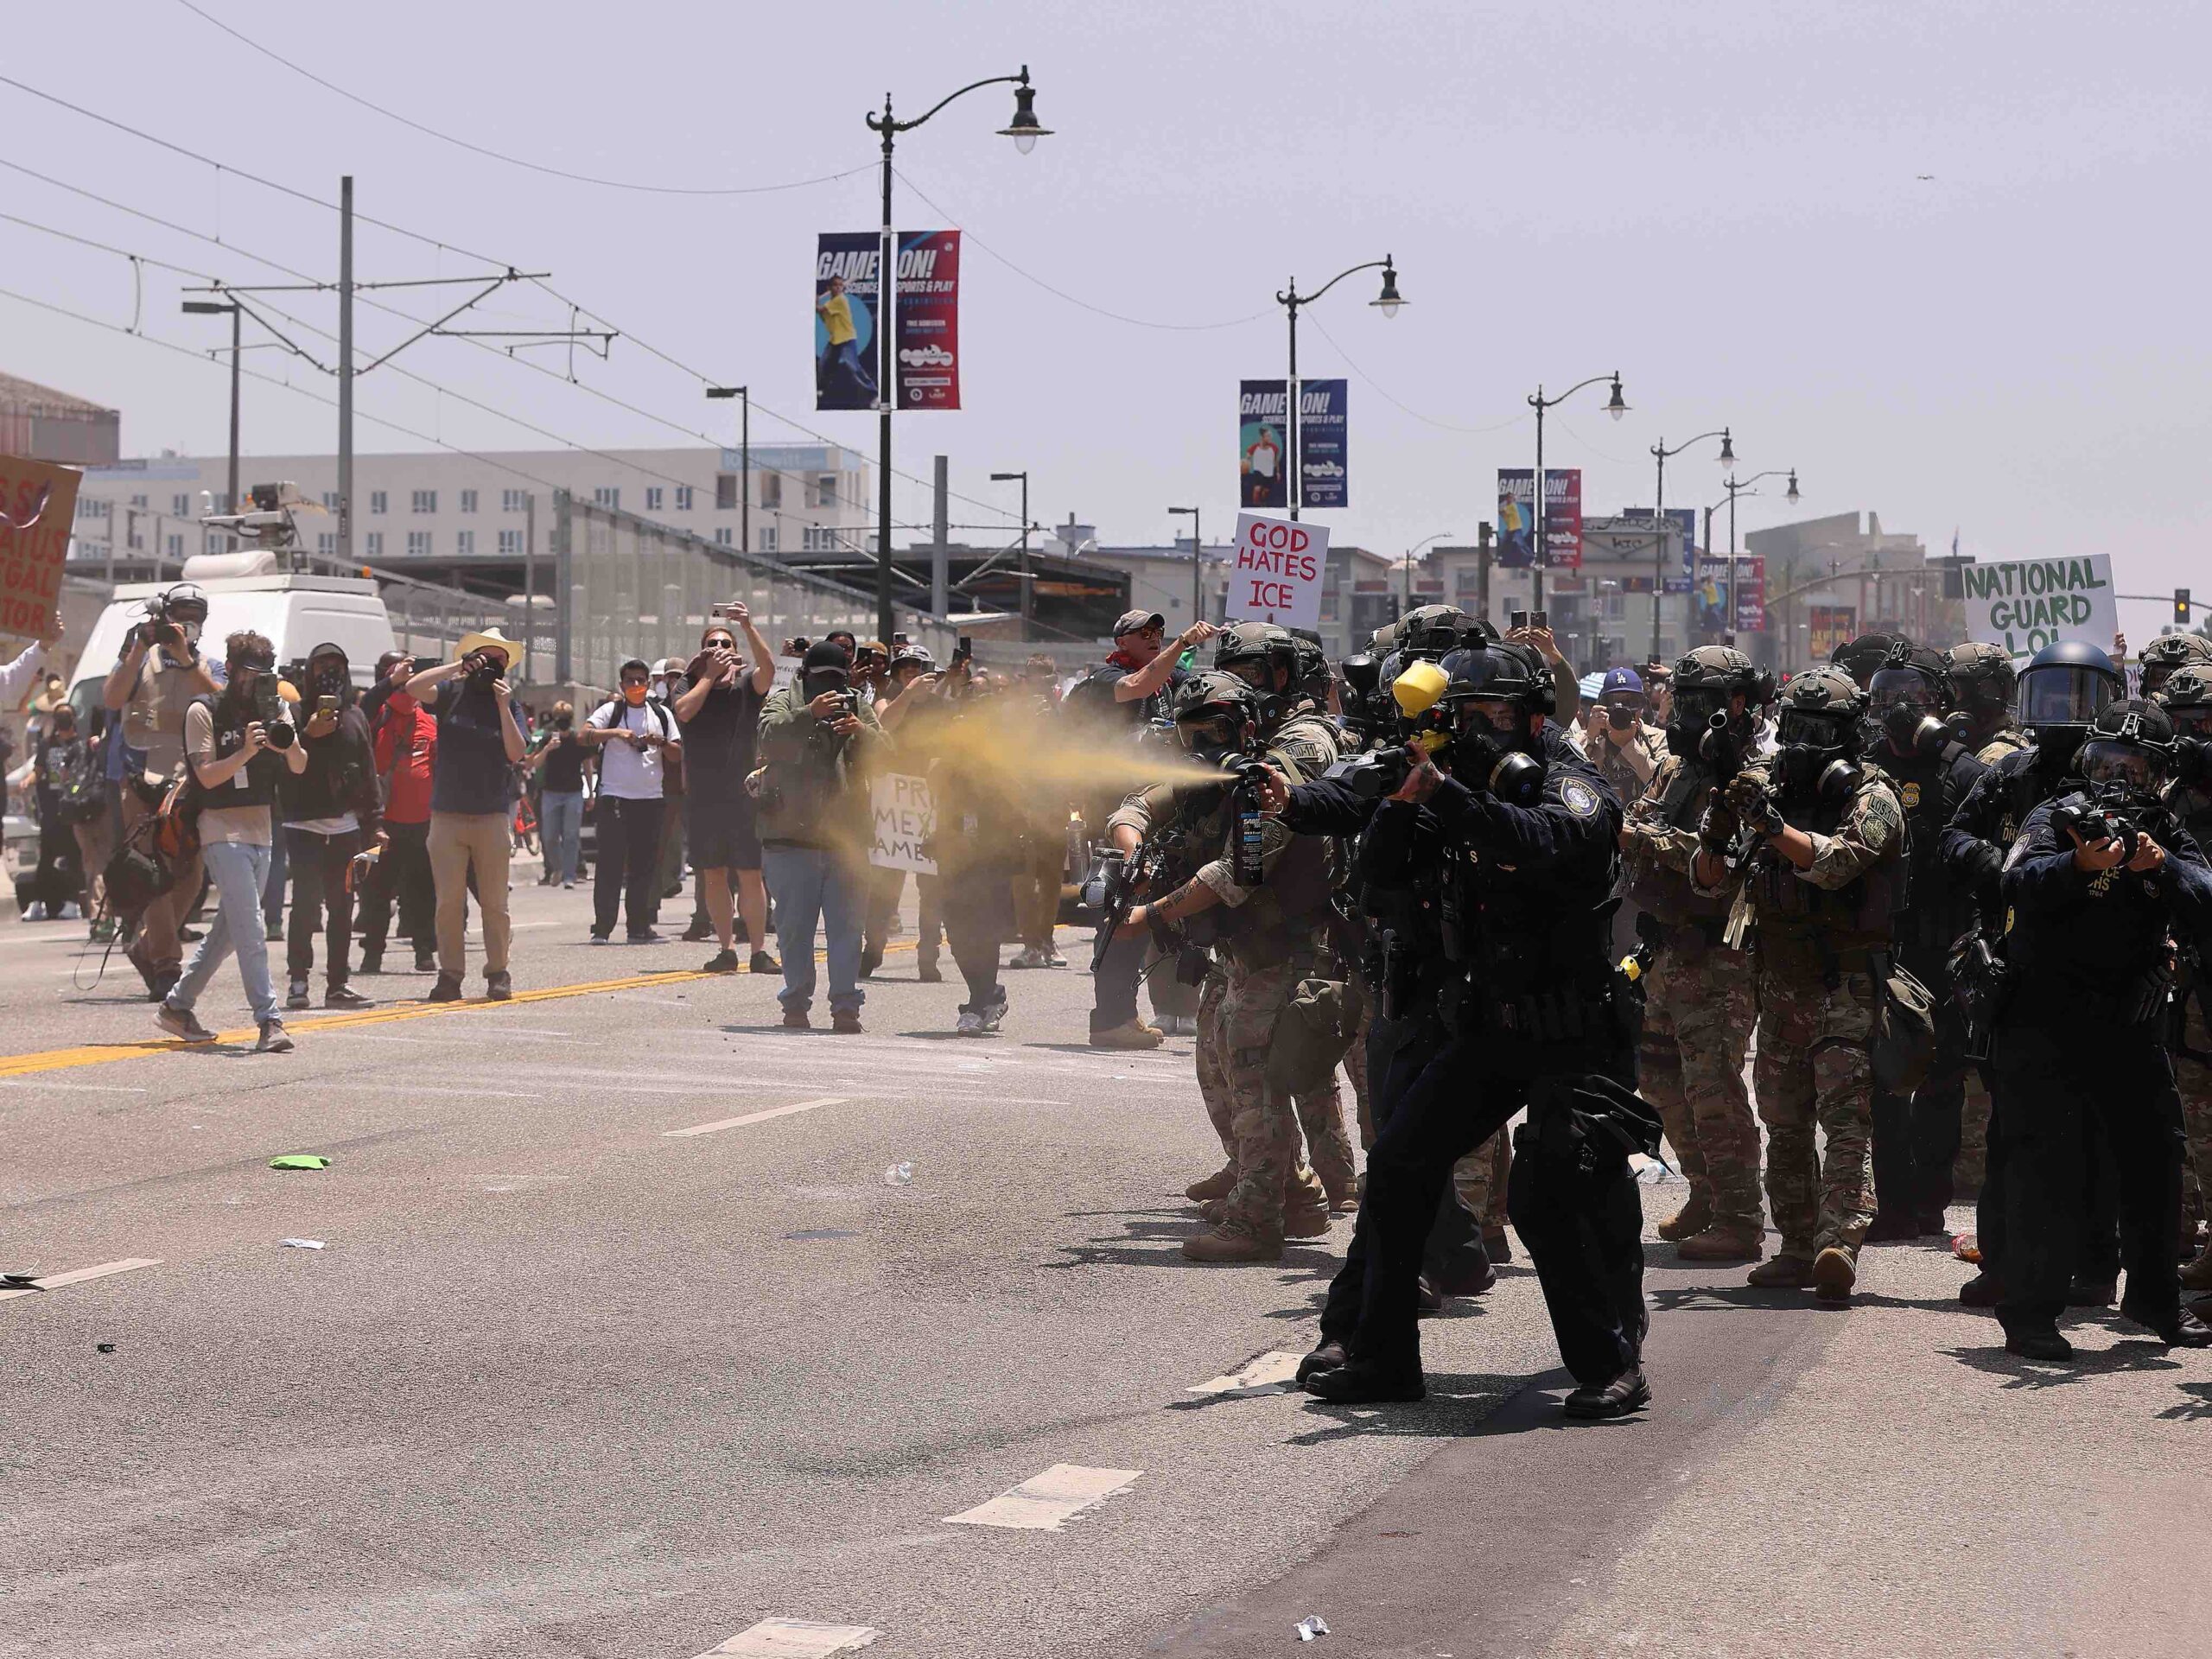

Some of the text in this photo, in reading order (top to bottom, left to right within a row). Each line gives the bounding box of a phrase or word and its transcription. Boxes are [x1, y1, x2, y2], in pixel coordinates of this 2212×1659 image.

[817, 250, 937, 280] GAME ON!
[896, 281, 925, 293] SPORTS
[926, 281, 934, 292] &
[935, 281, 955, 292] PLAY
[1241, 392, 1330, 415] GAME ON!
[1499, 479, 1568, 495] GAME ON!
[1249, 522, 1309, 553] GOD
[1237, 546, 1317, 582] HATES
[1964, 558, 2107, 600] NATIONAL
[1249, 580, 1294, 609] ICE
[0, 596, 46, 633] TOR
[1990, 594, 2092, 631] GUARD
[1617, 672, 1626, 683] LA
[1567, 780, 1598, 801] POLICE
[874, 838, 931, 864] AME
